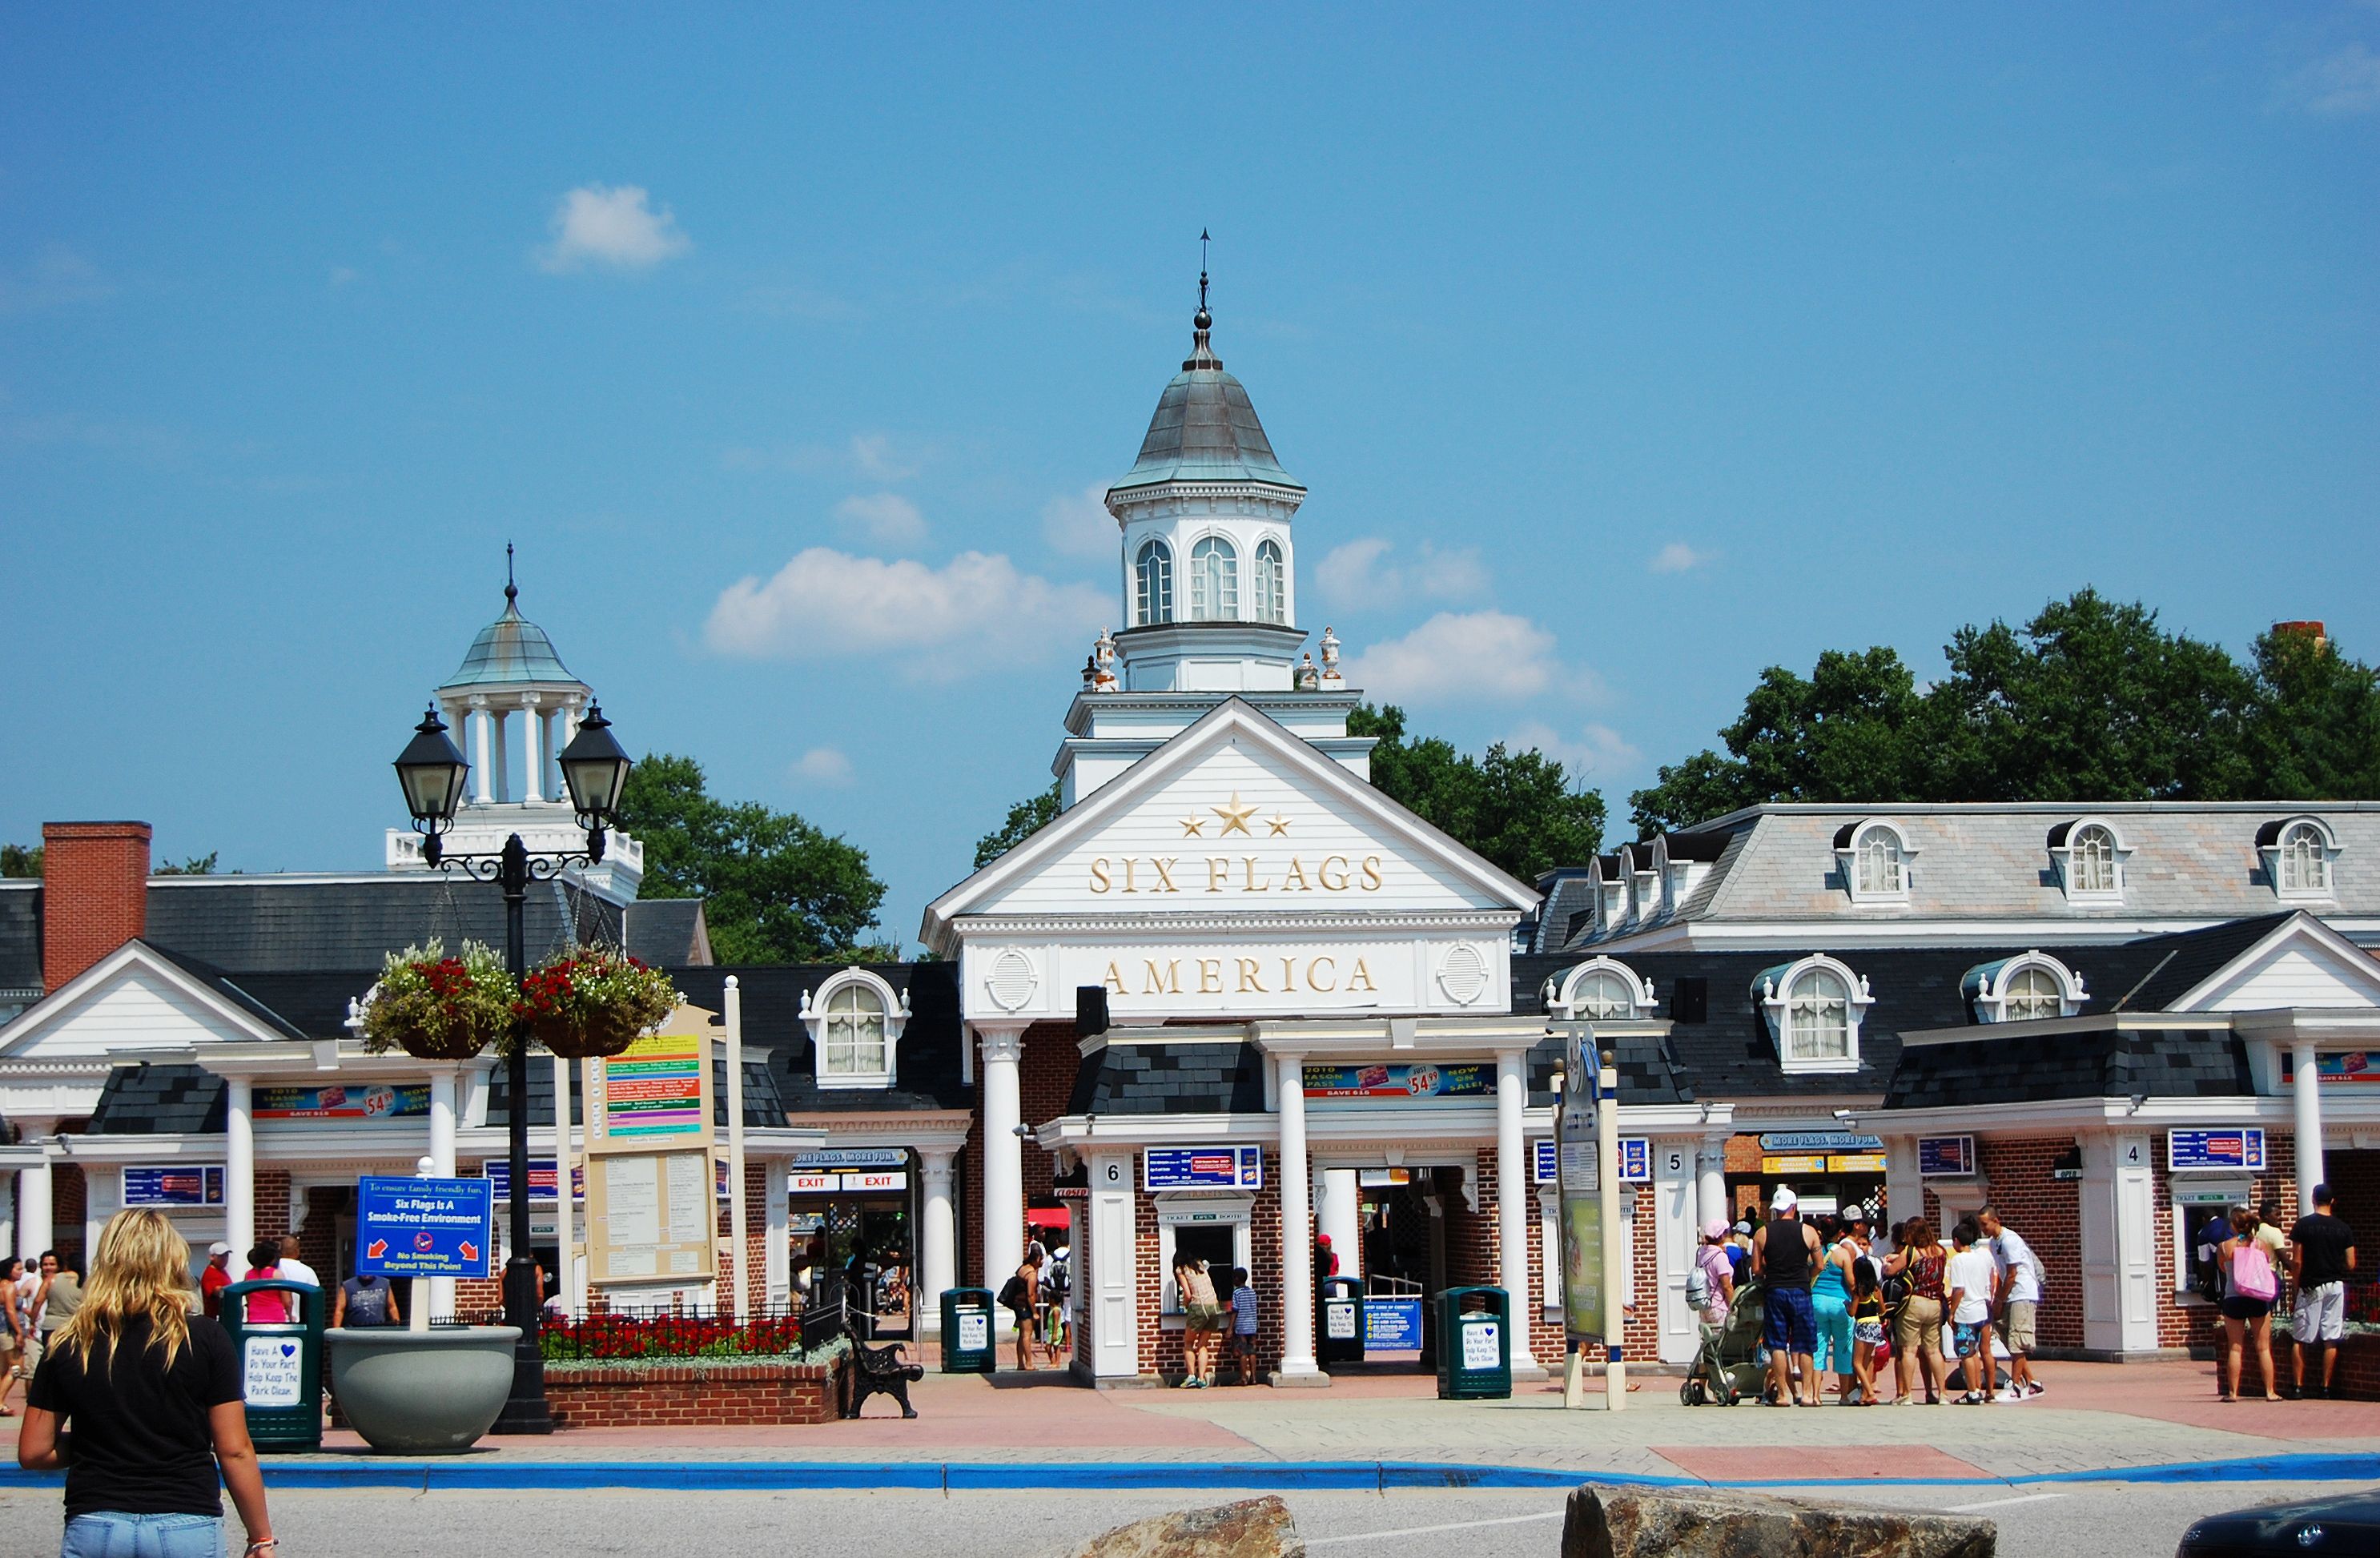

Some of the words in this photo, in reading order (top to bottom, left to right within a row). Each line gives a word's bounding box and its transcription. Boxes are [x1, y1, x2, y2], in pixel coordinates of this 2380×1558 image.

[1089, 856, 1180, 893] SIX
[1204, 853, 1383, 892] FLAGS
[1102, 954, 1378, 994] AMERICA
[1413, 1066, 1426, 1074] JUST
[1448, 1066, 1479, 1075] NOW
[1449, 1081, 1483, 1091] SALE!
[1772, 1137, 1799, 1146] MORE
[1799, 1137, 1828, 1145] FLAGS.
[1830, 1136, 1857, 1145] MORE
[793, 1153, 814, 1163] ORE
[815, 1153, 845, 1162] FLAGS.
[846, 1152, 872, 1161] MORE
[873, 1151, 895, 1161] FUN.
[2129, 1146, 2138, 1161] 4
[1670, 1154, 1680, 1170] 5
[1108, 1165, 1119, 1181] 6
[798, 1179, 825, 1187] EXIT
[866, 1176, 891, 1186] EXIT
[370, 1183, 380, 1191] To
[408, 1183, 432, 1195] family
[435, 1184, 464, 1195] friendly
[1056, 1188, 1087, 1196] CLOSED
[395, 1199, 409, 1210] Six
[411, 1199, 435, 1211] Flags
[436, 1200, 445, 1210] Is
[446, 1200, 454, 1210] A
[368, 1211, 420, 1223] Smoke-Free
[421, 1213, 481, 1224] Environment
[412, 1252, 449, 1262] Smoking
[384, 1262, 417, 1271] Beyond
[419, 1262, 436, 1270] This
[438, 1263, 461, 1271] Point
[251, 1346, 269, 1355] Have
[261, 1359, 277, 1368] Your
[249, 1372, 263, 1383] Help
[265, 1372, 282, 1383] Keep
[285, 1372, 297, 1382] The
[251, 1386, 269, 1395] Park
